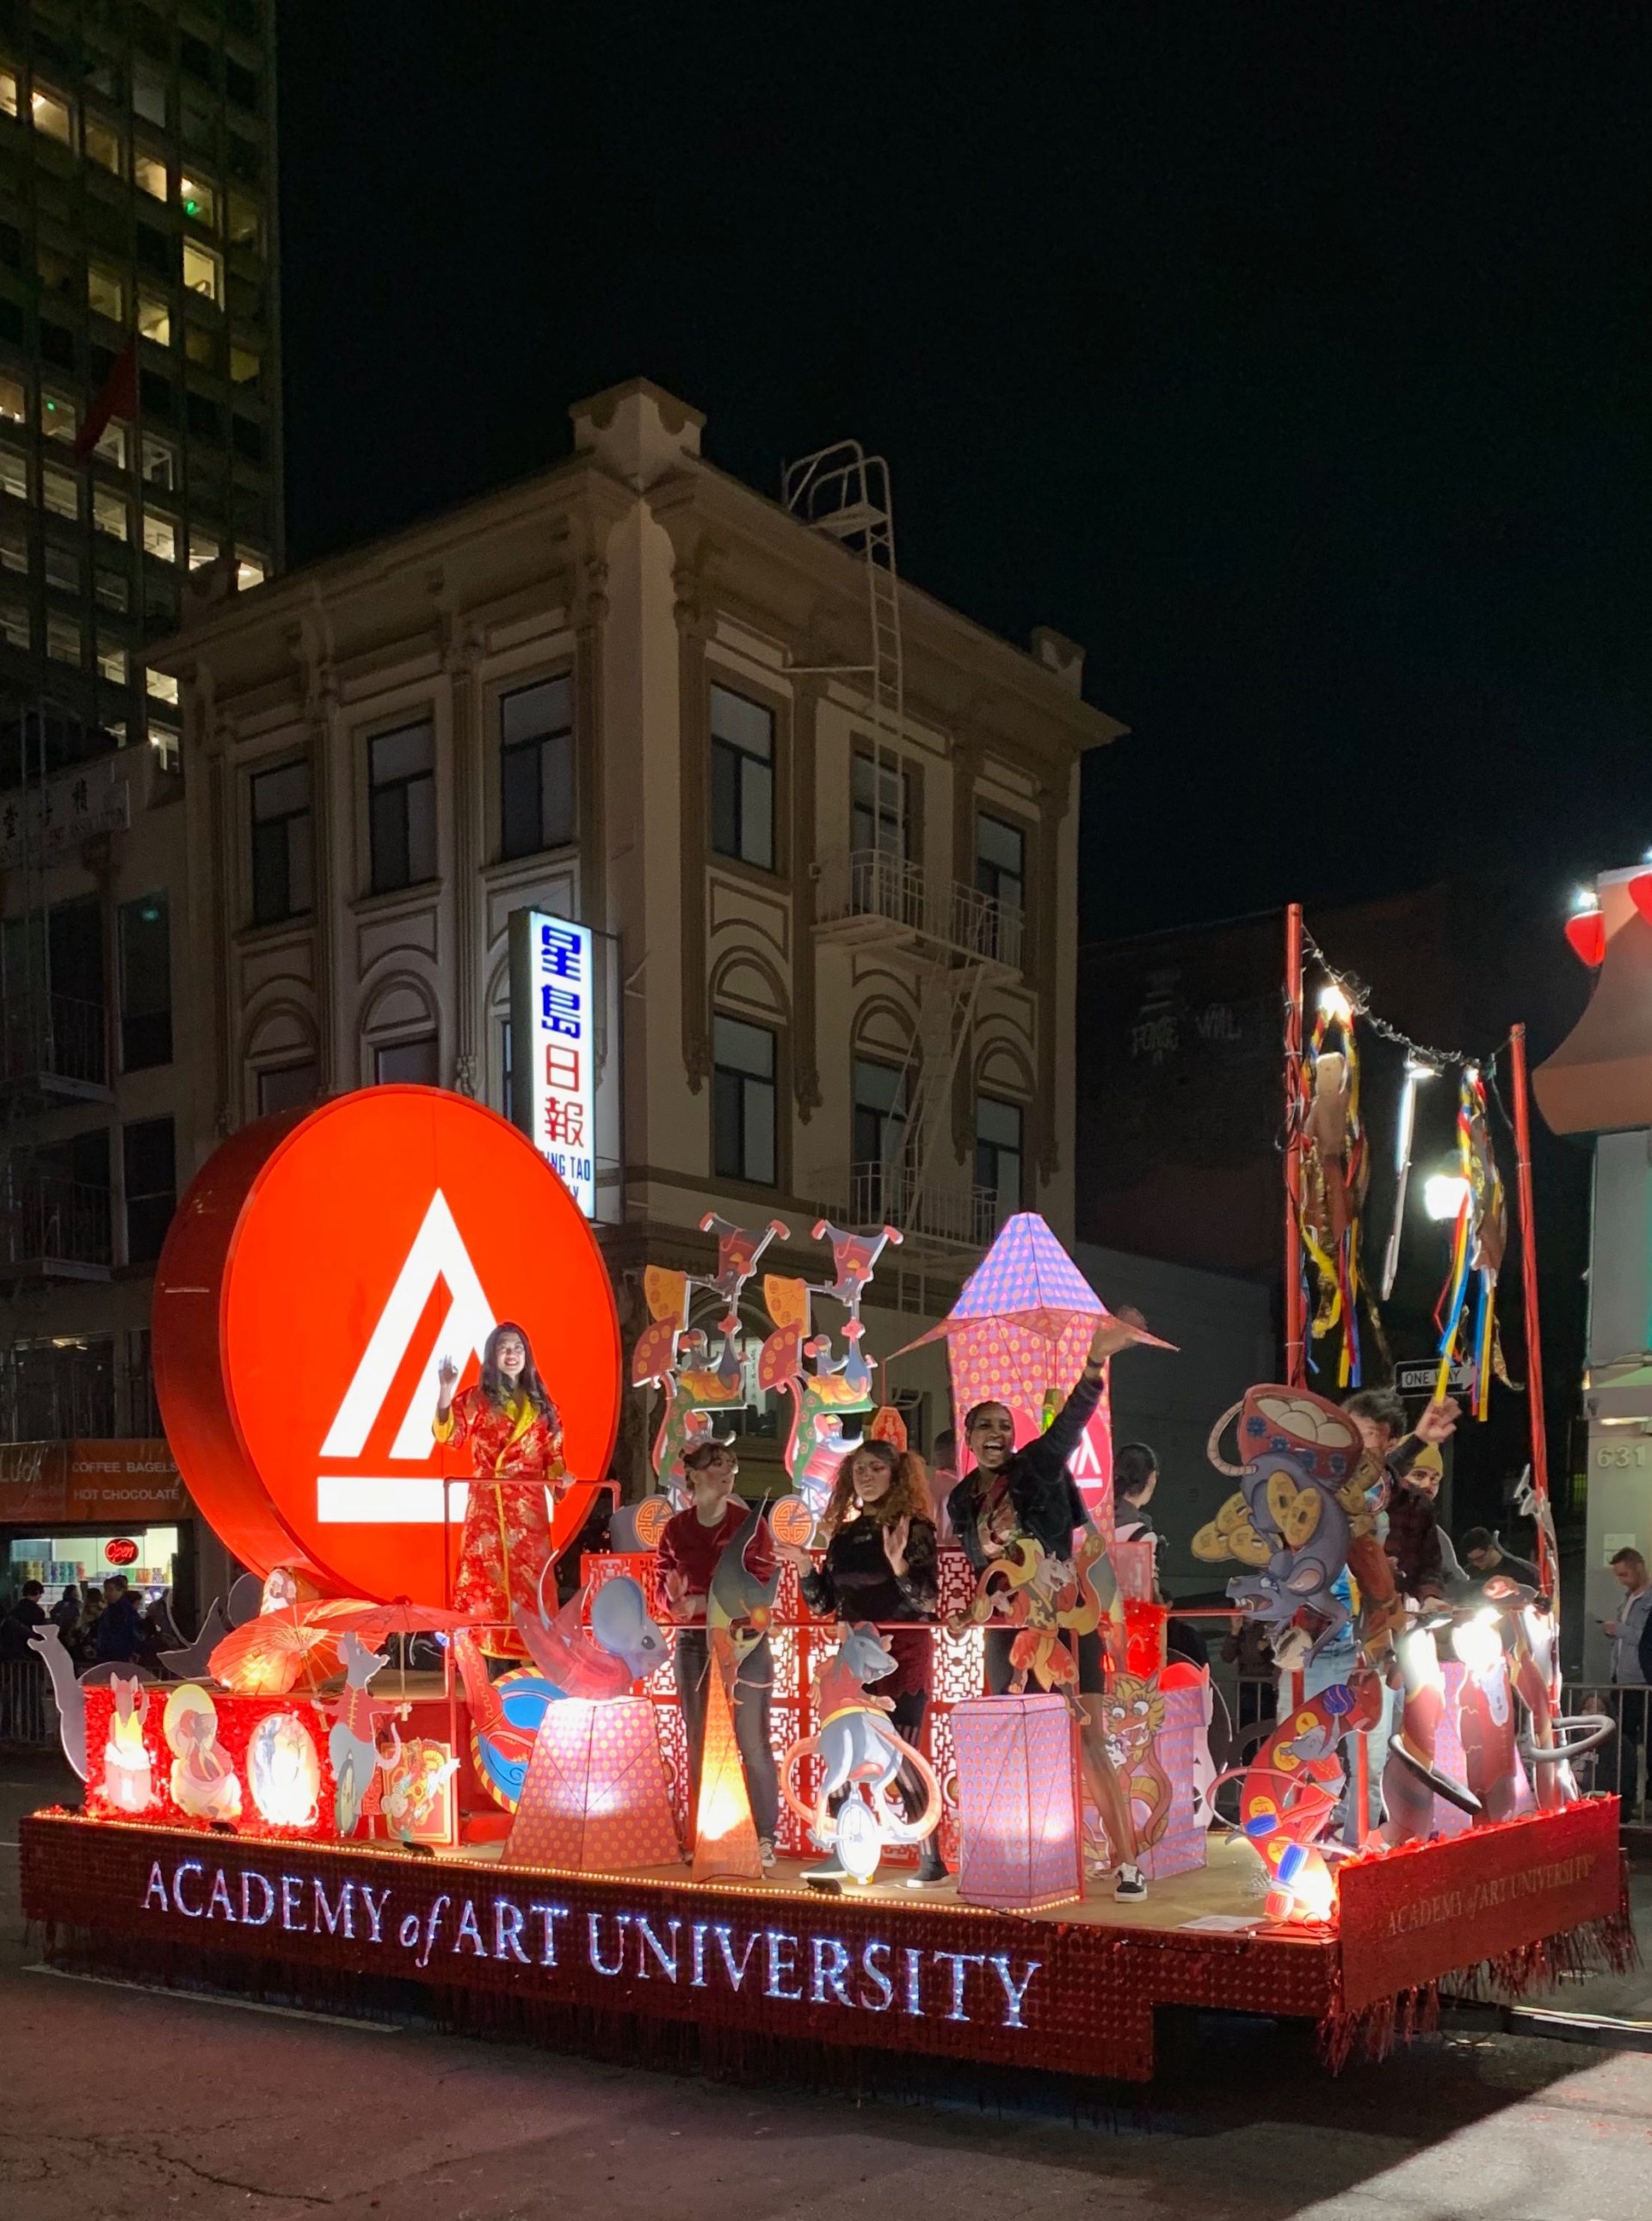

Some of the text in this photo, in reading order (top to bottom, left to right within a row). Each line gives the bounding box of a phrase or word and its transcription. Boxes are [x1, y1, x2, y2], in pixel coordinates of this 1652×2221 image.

[541, 923, 584, 1148] 星島日報
[540, 1151, 591, 1181] NG TAO
[1405, 1372, 1430, 1385] ONE
[71, 1461, 179, 1472] COFFEE BAGELS
[1596, 1446, 1646, 1468] 631
[74, 1490, 98, 1499] HOT
[102, 1490, 180, 1500] CHOCOLATE
[106, 1541, 135, 1562] Open
[1387, 1889, 1464, 1936] ACADEMY
[1480, 1876, 1507, 1909] ART
[140, 1860, 1044, 2029] ACADEMY of ART UNIVERSITY
